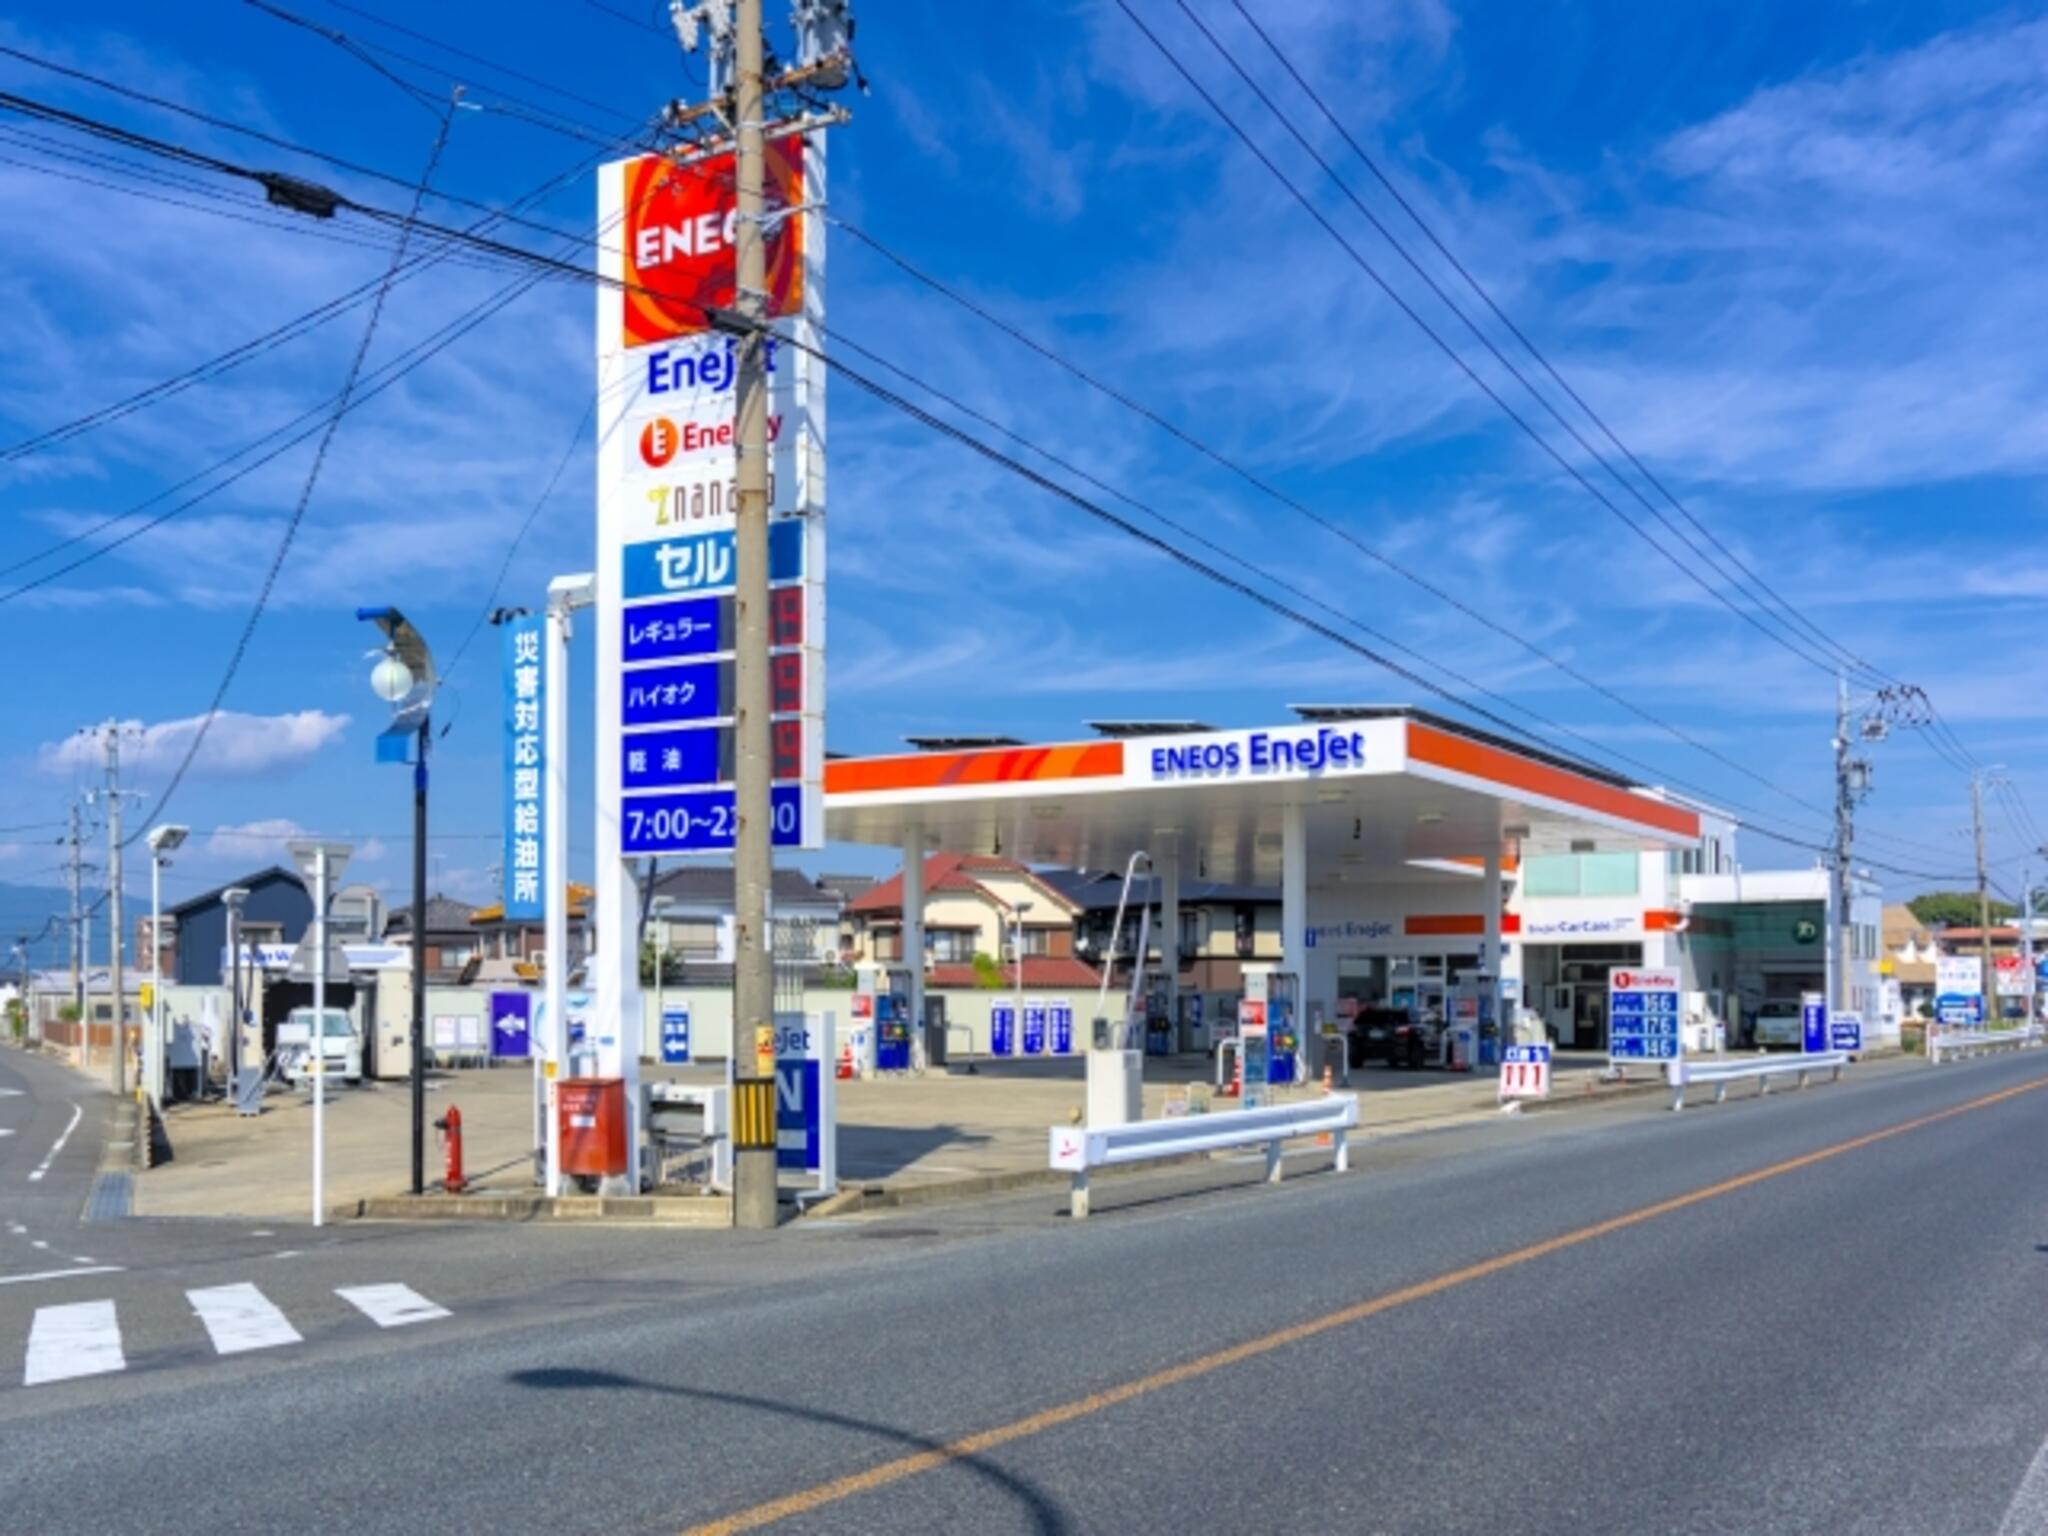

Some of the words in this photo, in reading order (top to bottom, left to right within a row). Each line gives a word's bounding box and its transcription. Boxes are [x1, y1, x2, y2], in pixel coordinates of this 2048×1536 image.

[635, 206, 740, 269] ENE
[648, 336, 777, 394] EneJt
[683, 414, 782, 450] Eney
[656, 535, 737, 588] セル
[629, 617, 711, 645] レギュラー
[627, 681, 696, 708] ハイオク
[1151, 743, 1240, 773] ENEOS
[1249, 728, 1364, 770] EneJet
[775, 1068, 803, 1112] N
